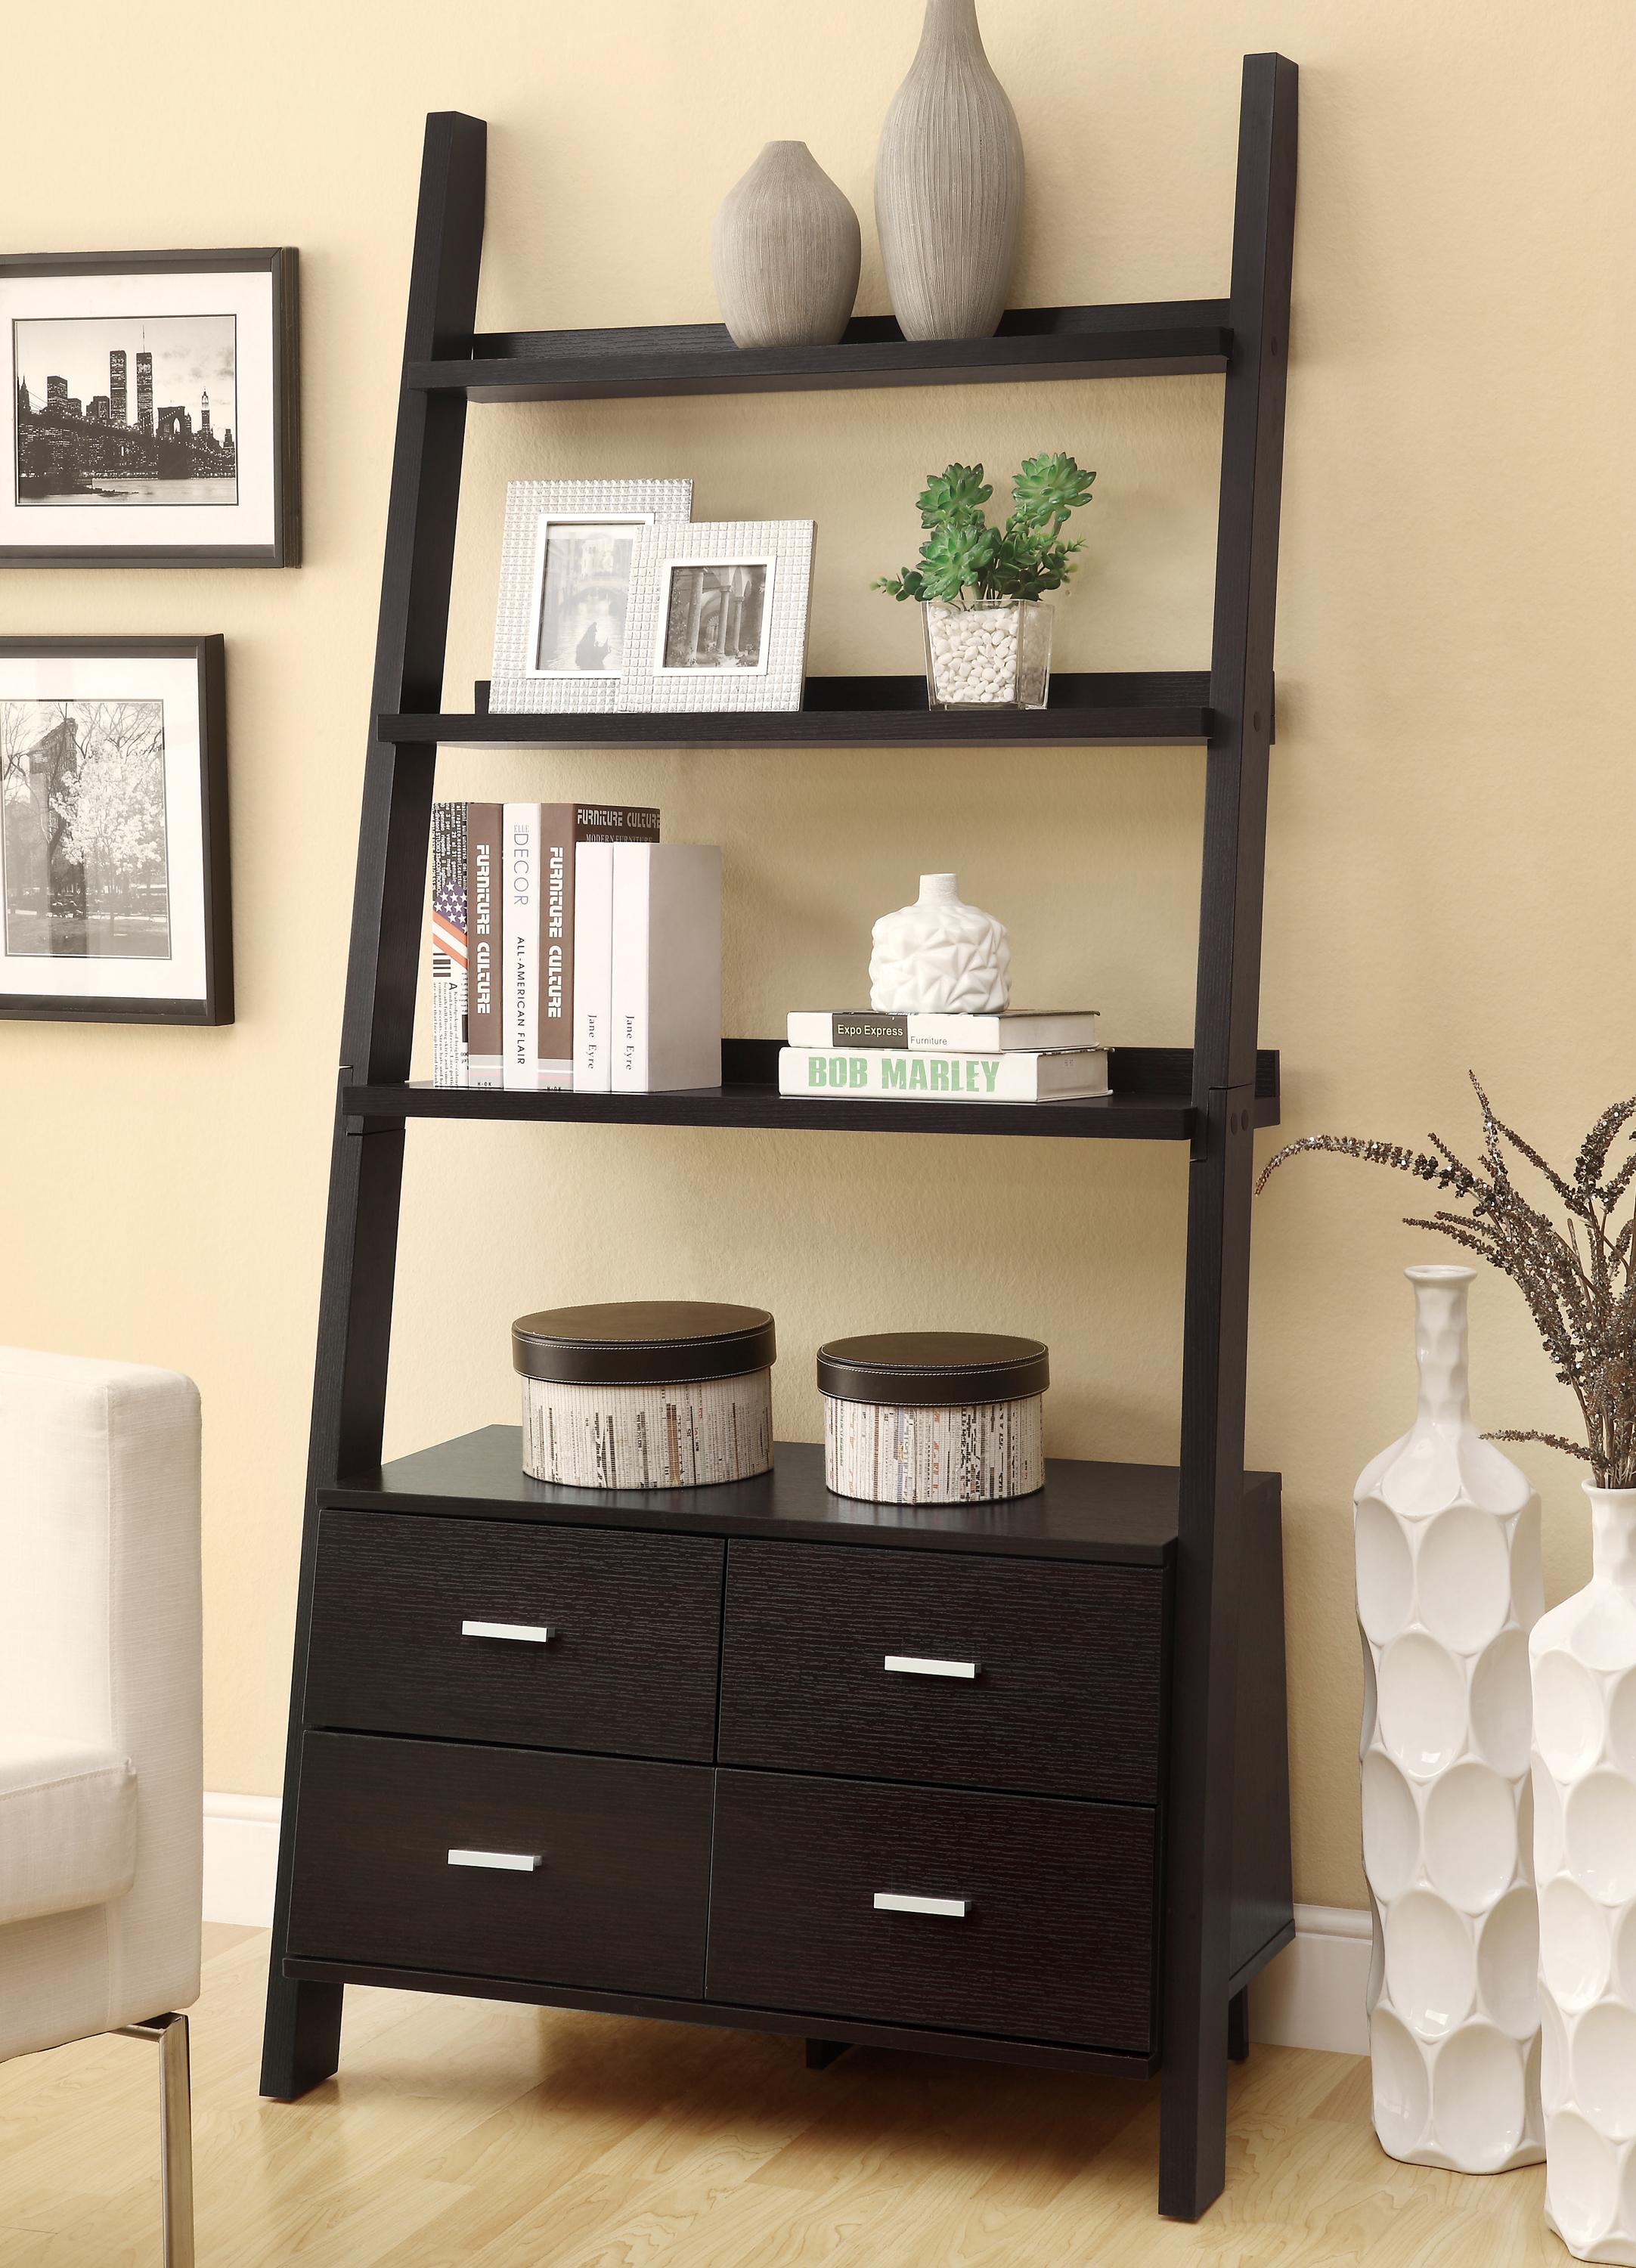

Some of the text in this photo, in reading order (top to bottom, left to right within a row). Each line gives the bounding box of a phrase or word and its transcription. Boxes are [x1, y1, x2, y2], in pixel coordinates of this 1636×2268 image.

[513, 824, 530, 832] ELLE
[577, 809, 660, 829] FURNITURE CULTURE
[513, 832, 529, 906] DECOR
[476, 844, 491, 1014] FURNITURE CULTURE
[548, 847, 563, 1018] FURNITURE CULTURE
[585, 1014, 596, 1070] Jane Eyre
[624, 1015, 635, 1070] Jane Eyre
[838, 1024, 903, 1037] Expo Express
[910, 1036, 947, 1045] Furniture
[807, 1056, 1000, 1092] BOB MARLEY
